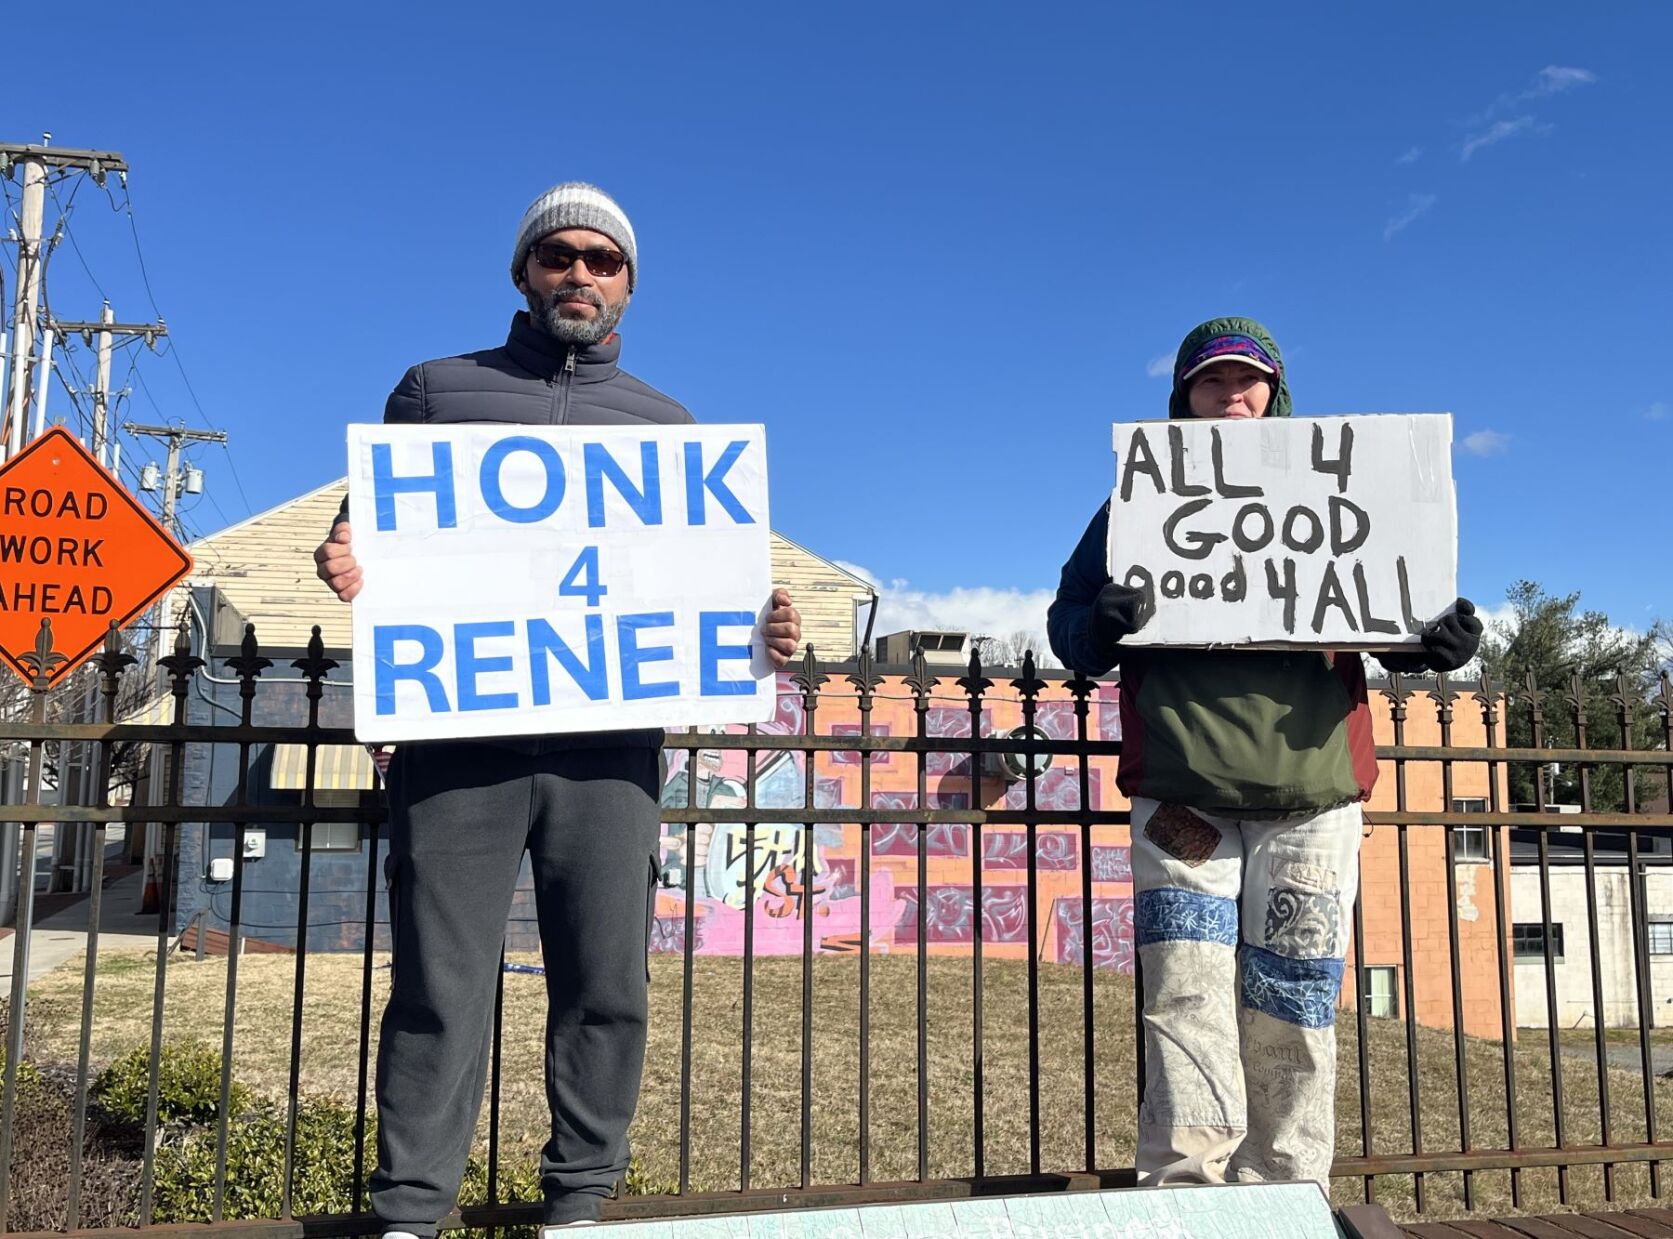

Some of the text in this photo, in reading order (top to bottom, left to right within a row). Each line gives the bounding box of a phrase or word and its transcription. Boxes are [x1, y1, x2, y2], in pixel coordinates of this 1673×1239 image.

[371, 436, 757, 532] HONK
[1120, 422, 1354, 502] ALL 4
[4, 487, 108, 520] ROAD
[1162, 495, 1371, 560] GOOD
[0, 534, 105, 568] WORK
[558, 546, 608, 607] 4
[1264, 556, 1298, 635] 4
[1311, 555, 1437, 635] ALL
[373, 610, 758, 716] RENEE
